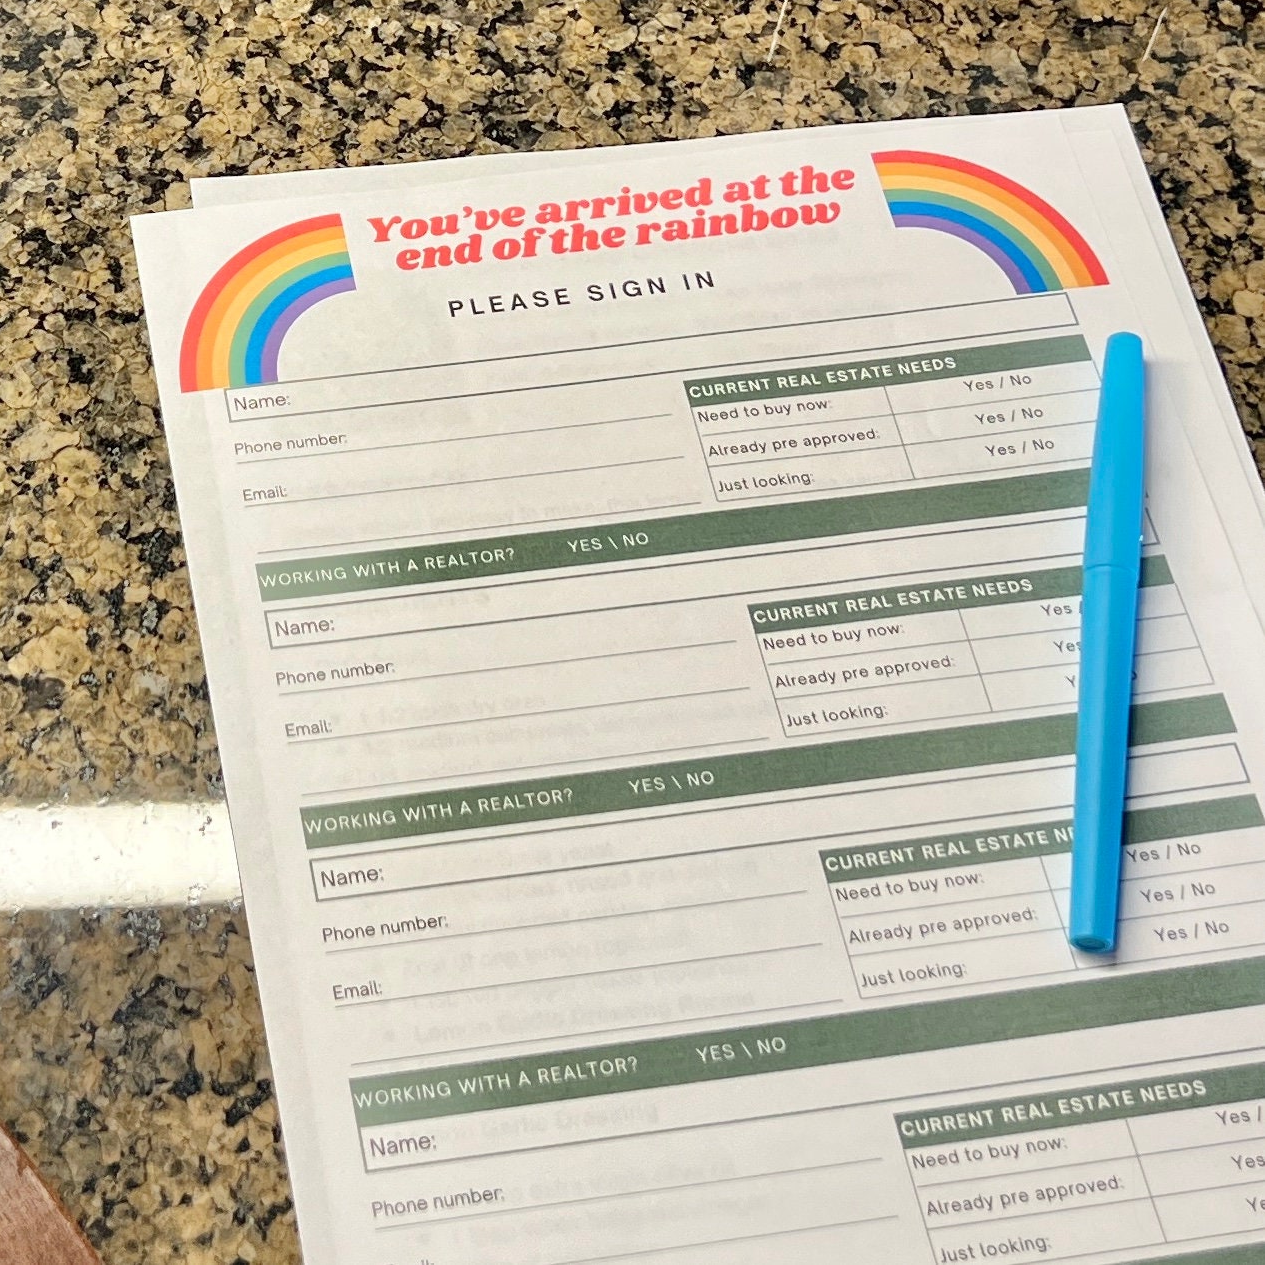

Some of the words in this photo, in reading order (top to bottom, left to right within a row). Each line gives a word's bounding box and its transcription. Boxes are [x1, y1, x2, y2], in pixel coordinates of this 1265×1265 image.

[367, 203, 525, 243] You've
[534, 177, 713, 224] arrived
[723, 178, 771, 204] at
[778, 165, 856, 193] the
[395, 232, 483, 271] end
[492, 226, 547, 261] of
[549, 218, 624, 253] the
[634, 197, 841, 246] rainbow
[448, 287, 571, 318] PLEASE
[587, 277, 667, 303] SIGN
[683, 271, 717, 291] IN
[689, 378, 771, 399] CURRENT
[778, 372, 822, 387] REAL
[826, 364, 893, 383] ESTATE
[898, 356, 957, 375] NEEDS
[963, 378, 994, 393] Yes
[1010, 372, 1032, 387] No
[234, 394, 291, 412] Name:
[697, 406, 740, 424] Need
[743, 404, 760, 417] to
[764, 399, 792, 417] buy
[975, 411, 1006, 426] Yes
[1022, 406, 1044, 420] No
[234, 439, 282, 456] Phone
[286, 433, 347, 450] number:
[708, 439, 767, 458] Already
[772, 437, 798, 453] pre
[985, 443, 1016, 457] Yes
[1032, 438, 1055, 452] No
[242, 485, 288, 502] Email:
[718, 477, 749, 494] Just
[751, 471, 815, 489] looking:
[567, 537, 602, 554] YES
[623, 532, 649, 548] NO
[259, 567, 347, 589] WORKING
[352, 560, 400, 578] WITH
[407, 557, 420, 572] A
[424, 547, 515, 570] REALTOR?
[753, 602, 839, 625] CURRENT
[846, 594, 893, 613] REAL
[897, 586, 968, 607] ESTATE
[972, 578, 1033, 598] NEEDS
[1040, 602, 1073, 618] Yes
[274, 617, 335, 638] Name:
[763, 634, 806, 652] Need
[810, 630, 828, 644] to
[833, 626, 862, 644] buy
[275, 667, 326, 686] Phone
[331, 660, 396, 679] number:
[774, 669, 836, 690] Already
[842, 666, 869, 684] pre
[285, 720, 333, 738] Email:
[786, 711, 818, 729] Just
[821, 704, 888, 725] looking:
[628, 777, 666, 795] YES
[687, 769, 715, 787] NO
[304, 810, 396, 835] WORKING
[402, 802, 453, 823] WITH
[459, 799, 472, 816] A
[478, 788, 573, 812] REALTOR?
[825, 847, 916, 873] CURRENT
[922, 839, 971, 861] REAL
[975, 830, 1049, 853] ESTATE
[1126, 846, 1161, 863] Yes
[1177, 841, 1202, 857] No
[320, 866, 385, 889] Name:
[835, 884, 881, 903] Need
[884, 880, 904, 895] to
[908, 874, 939, 896] buy
[1139, 887, 1174, 904] Yes
[1191, 881, 1216, 898] No
[321, 922, 376, 944] Phone
[380, 913, 449, 937] number:
[848, 922, 913, 945] Already
[919, 919, 947, 938] pre
[1153, 925, 1188, 943] Yes
[1204, 919, 1229, 937] No
[859, 970, 895, 989] Just
[899, 962, 968, 985] looking:
[332, 978, 383, 1001] Email:
[695, 1043, 736, 1064] YES
[758, 1036, 787, 1056] NO
[353, 1081, 451, 1109] WORKING
[457, 1072, 511, 1095] WITH
[518, 1071, 532, 1087] A
[537, 1056, 638, 1083] REALTOR?
[900, 1109, 993, 1136] CURRENT
[1001, 1102, 1053, 1124] REAL
[1058, 1090, 1134, 1115] ESTATE
[1140, 1079, 1207, 1102] NEEDS
[370, 1134, 437, 1158] Name:
[372, 1196, 428, 1219] Phone
[433, 1186, 504, 1212] number:
